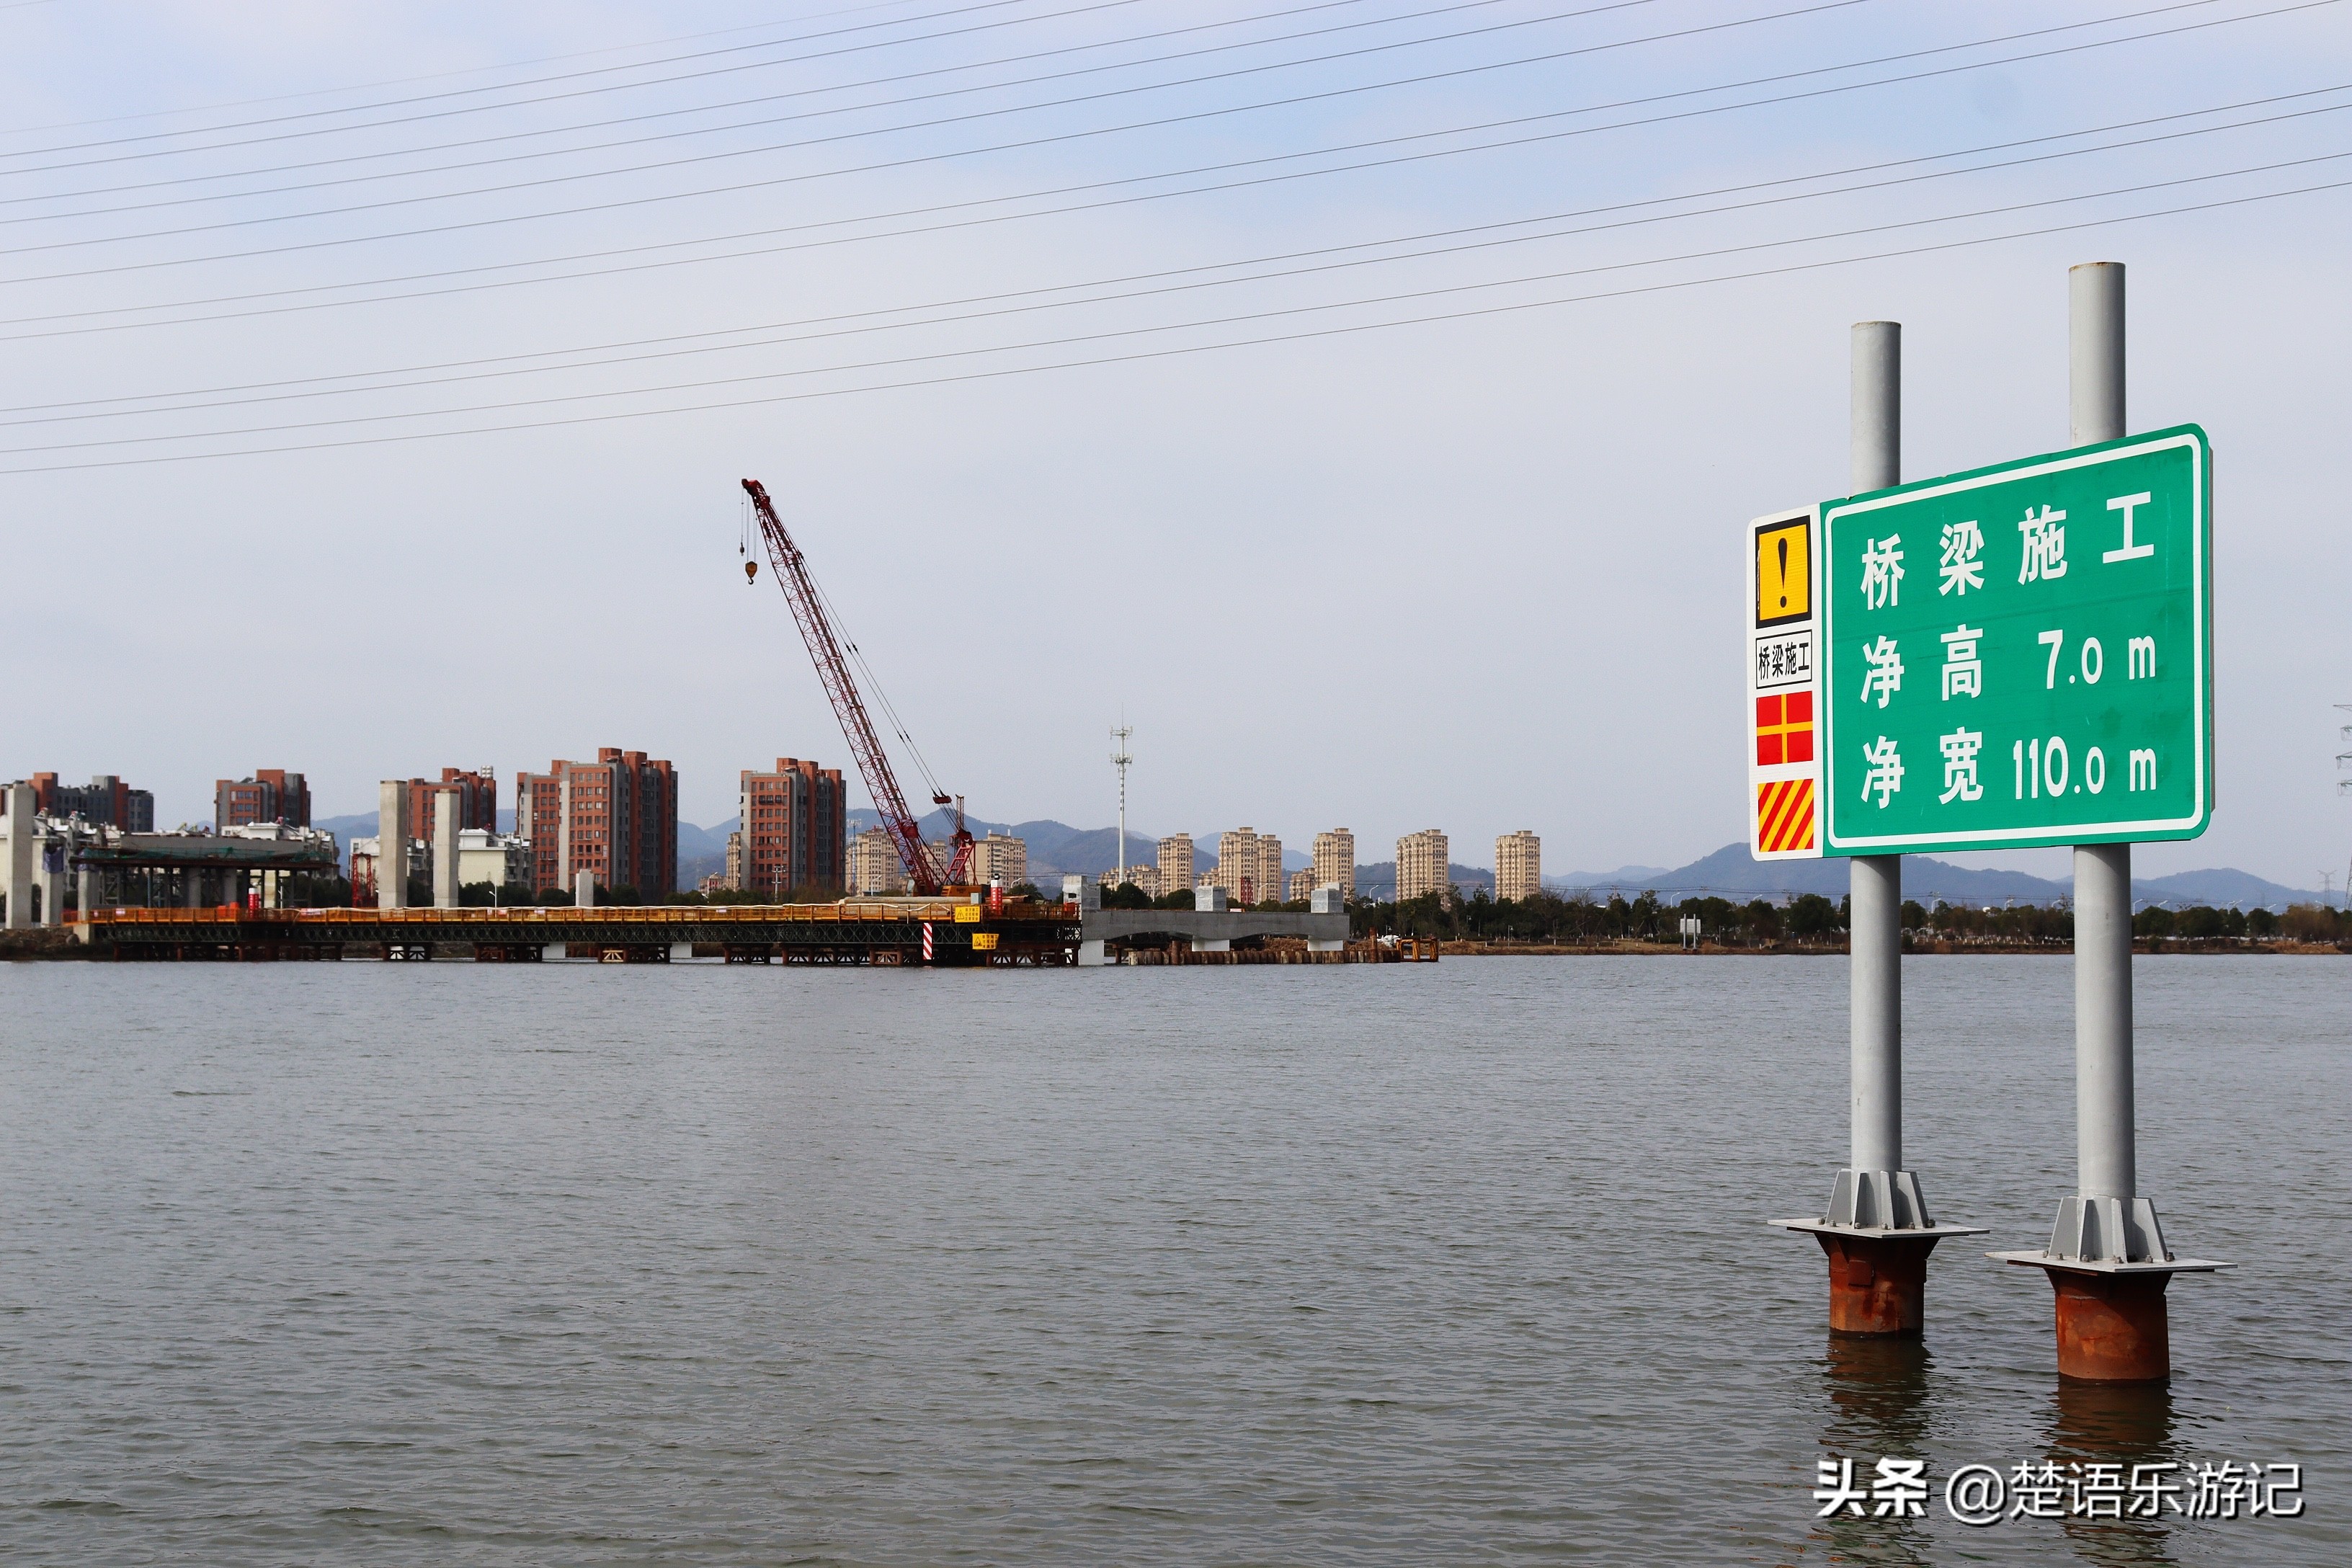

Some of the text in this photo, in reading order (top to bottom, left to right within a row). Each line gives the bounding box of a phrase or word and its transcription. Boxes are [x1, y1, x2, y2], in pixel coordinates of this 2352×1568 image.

[1759, 641, 1809, 680] 桥梁施工
[1861, 624, 2156, 709] 净高 7.0 m
[1861, 726, 2157, 809] 净宽 110.0 m
